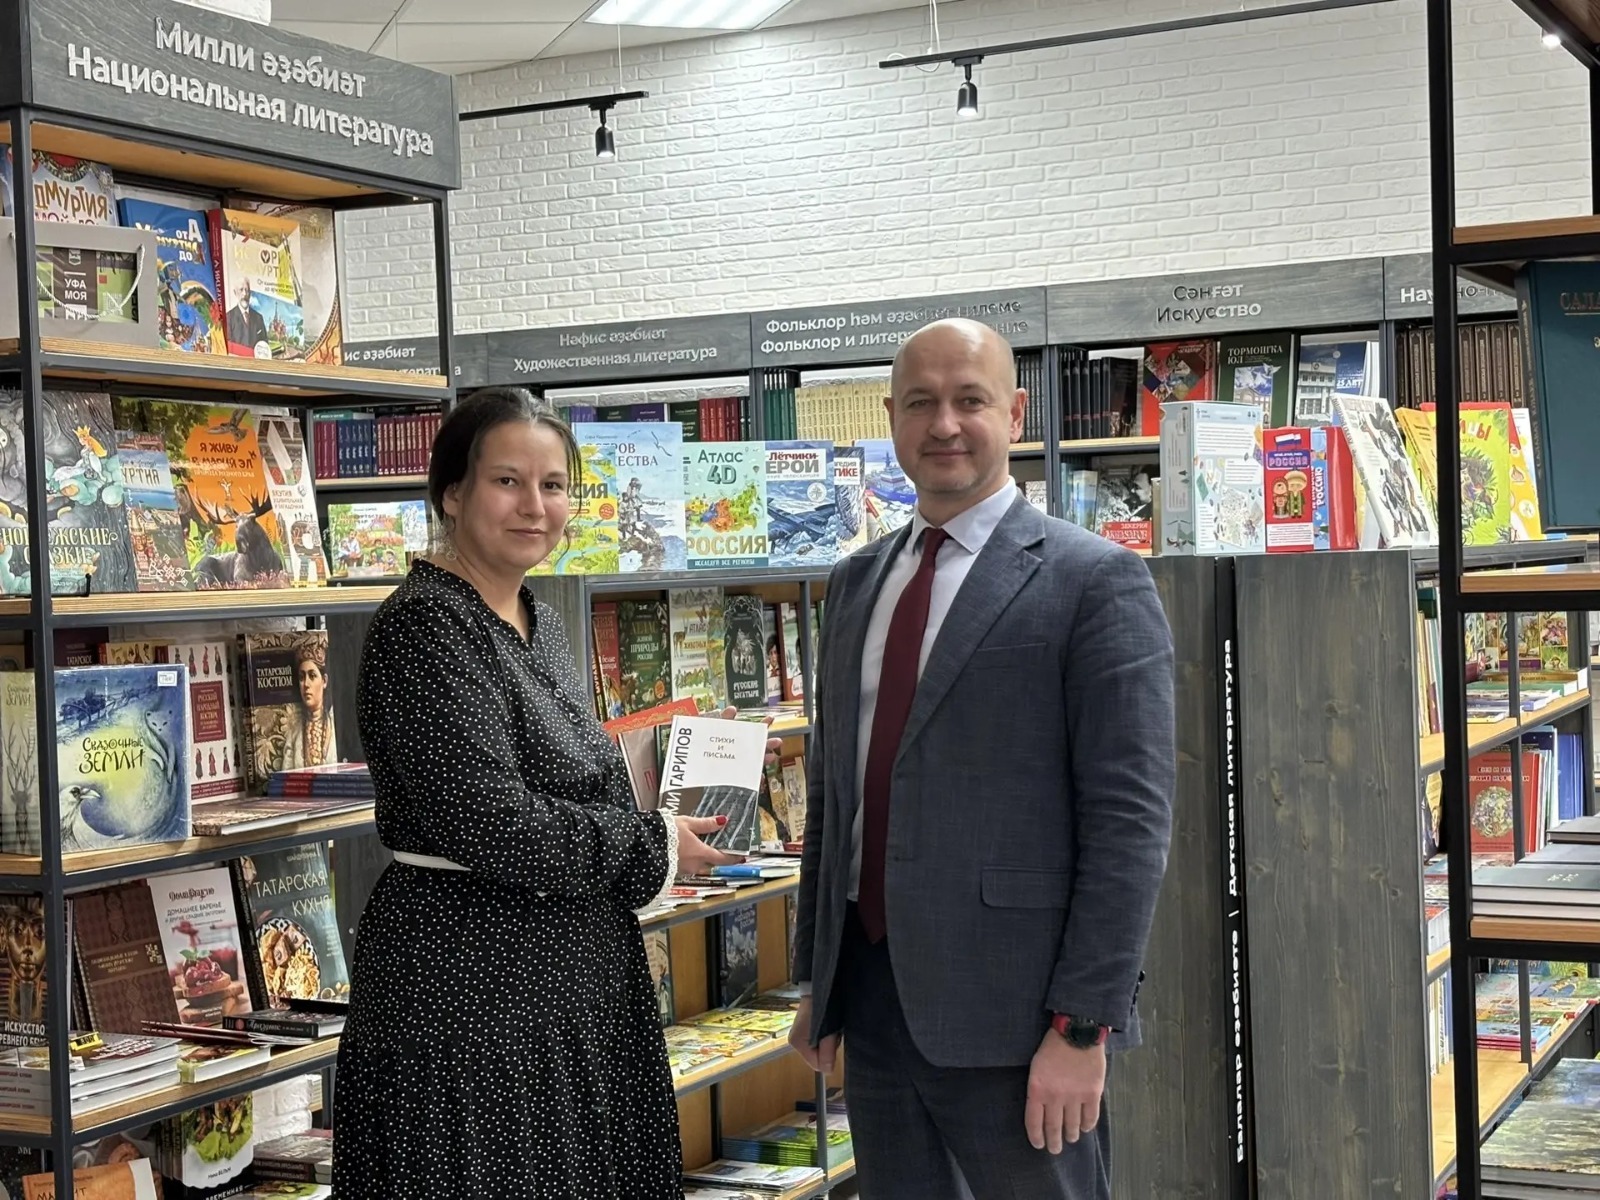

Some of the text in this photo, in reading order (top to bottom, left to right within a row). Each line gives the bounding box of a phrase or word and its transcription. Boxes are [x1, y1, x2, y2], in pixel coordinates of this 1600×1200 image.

[155, 16, 255, 71] Милли
[67, 42, 434, 156] Национальная литература
[34, 179, 109, 222] ДМУРТИЯ
[64, 278, 86, 290] УФА
[64, 290, 87, 301] МОЯ
[1156, 302, 1262, 324] Искусство
[766, 315, 847, 335] Фольклор
[850, 312, 883, 328] һәм
[760, 335, 841, 355] Фольклор
[845, 337, 856, 348] и
[513, 346, 718, 374] Художественная литература
[200, 442, 239, 454] Я ЖИВУ
[698, 449, 744, 464] Атлас
[765, 459, 820, 475] ЕРОИ
[1269, 455, 1309, 468] РОССИЯ
[707, 465, 737, 485] 4D
[2, 527, 119, 546] НОЕЖСКИЕ
[686, 535, 767, 556] РОССИЯ
[23, 546, 93, 565] САЗКИ
[256, 664, 293, 677] ТАТАРСКИЙ
[257, 676, 293, 689] КОСТЮМ
[709, 735, 736, 744] СТИХИ
[78, 748, 144, 775] ЗЕМЛИ
[670, 727, 693, 787] ГАРИПОВ
[703, 751, 737, 760] ПИСЬМА
[252, 870, 328, 898] ТАТАРСКАЯ
[291, 894, 332, 917] КУХНЯ
[4, 1021, 46, 1036] ИСКУССТВО
[0, 1034, 29, 1047] РЕВНЕГО
